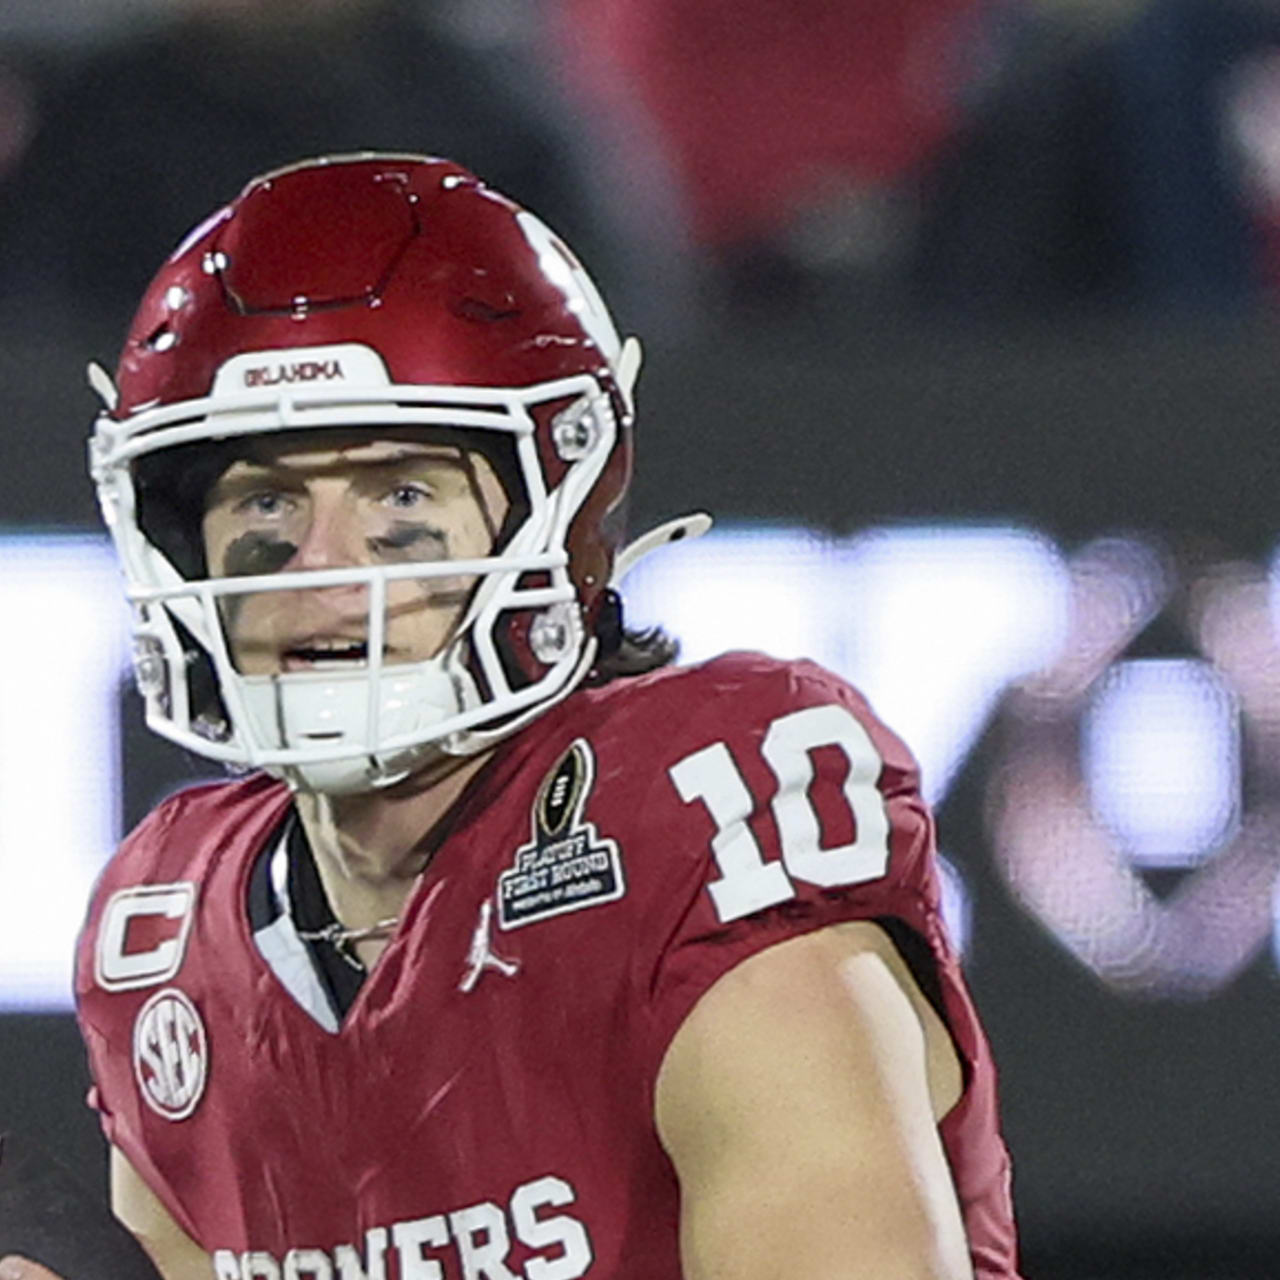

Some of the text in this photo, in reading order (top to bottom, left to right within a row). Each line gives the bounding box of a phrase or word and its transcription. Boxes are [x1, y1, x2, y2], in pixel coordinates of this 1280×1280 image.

[244, 360, 345, 388] OKLAHOMA
[670, 706, 889, 922] 10
[99, 891, 191, 982] C
